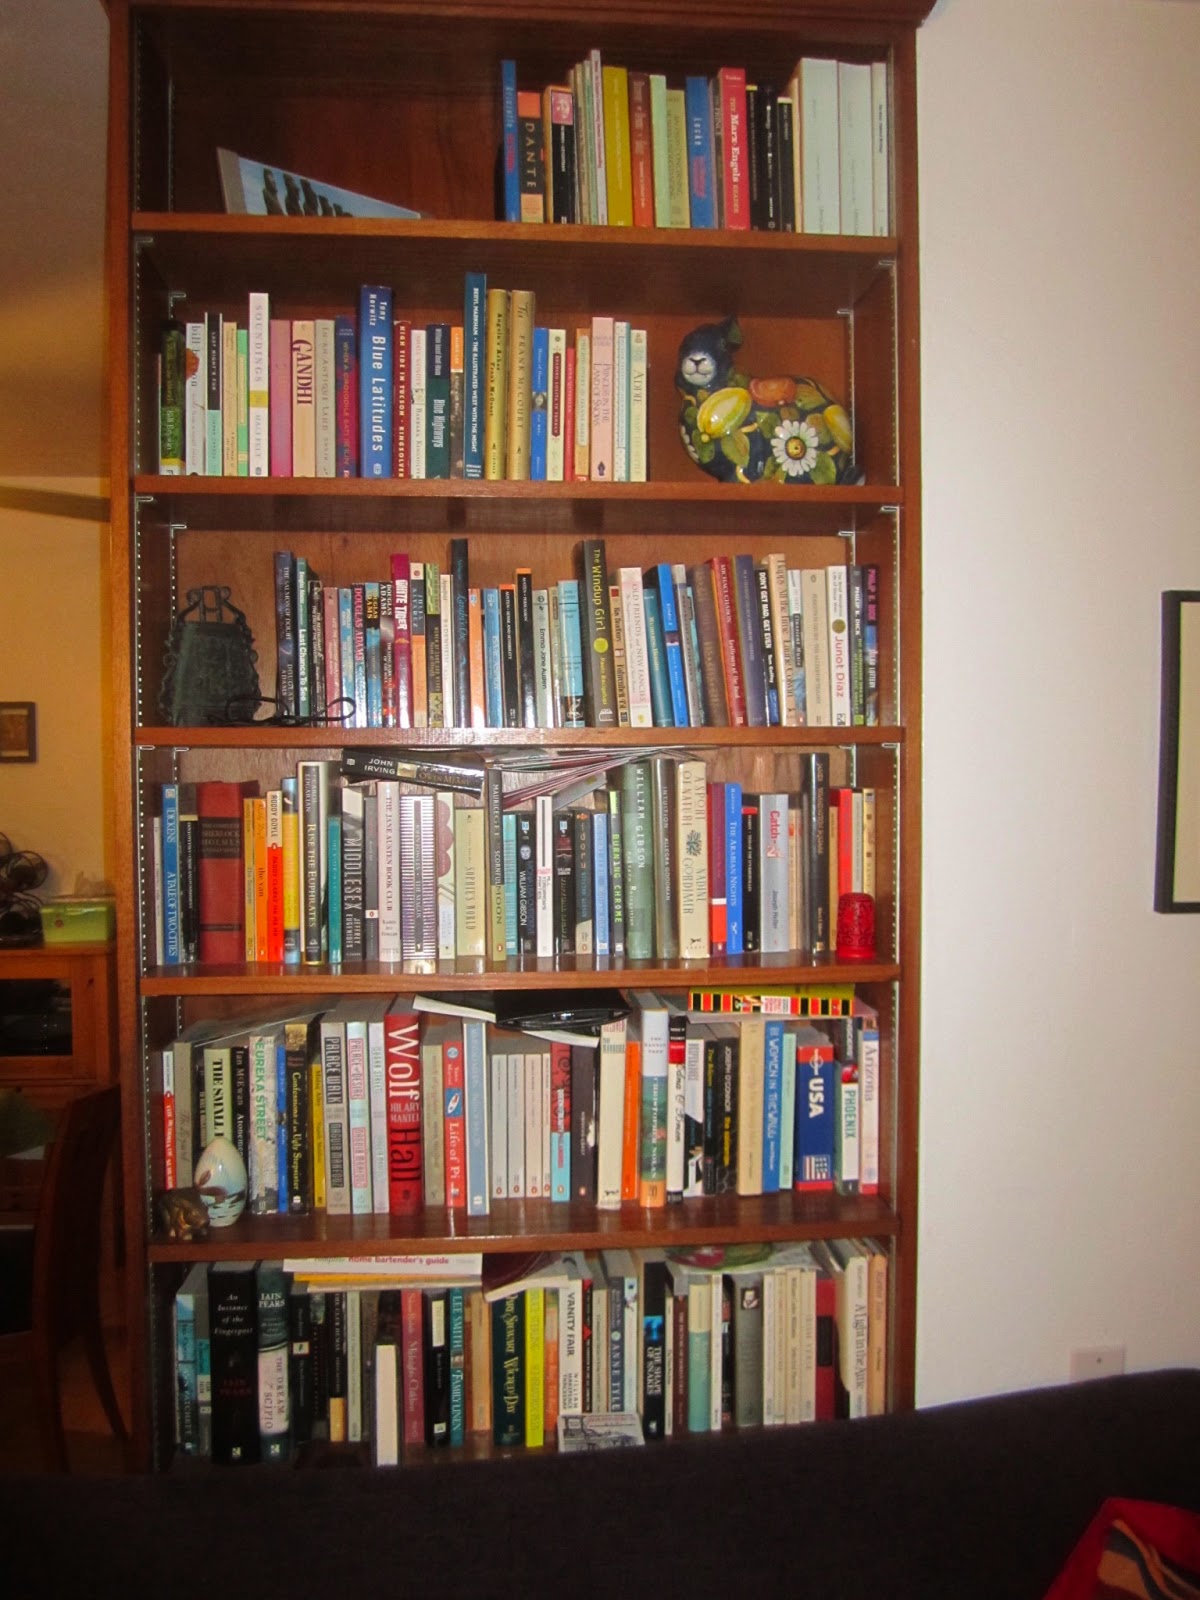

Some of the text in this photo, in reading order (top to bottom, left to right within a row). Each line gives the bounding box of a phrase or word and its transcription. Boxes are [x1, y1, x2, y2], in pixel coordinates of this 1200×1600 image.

[525, 122, 536, 188] DANTE
[369, 294, 377, 326] Horwitz
[255, 305, 263, 382] SOUNDINGS
[292, 340, 312, 405] GANDHI
[372, 336, 385, 451] Blue Latitudes
[433, 399, 445, 448] Blue Highways
[592, 566, 603, 605] Windup
[759, 572, 767, 589] DON'T
[760, 590, 768, 602] GET
[354, 588, 362, 628] DOUGLAS
[395, 580, 408, 630] WHITE TIGER
[595, 608, 605, 631] Girl
[763, 633, 772, 648] EVEN
[834, 636, 844, 669] Junot
[300, 677, 307, 685] To
[364, 765, 396, 775] IRVING
[369, 759, 393, 767] JOHN
[270, 795, 278, 817] RODDY
[385, 797, 393, 813] THE
[635, 768, 645, 868] WILLIAM GIBSON
[695, 784, 705, 820] SPORT
[385, 814, 393, 833] JANE
[385, 834, 393, 865] AUSTEN
[307, 823, 317, 927] RISE THE EUPHRATES
[344, 837, 361, 910] MIDDLESEX
[682, 858, 693, 914] GORDIMER
[696, 868, 706, 902] NADINE
[730, 877, 738, 906] NIGHTS
[212, 1059, 223, 1084] THE
[326, 1037, 342, 1103] PALACE WALK
[864, 1046, 877, 1101] Arizona
[255, 1042, 265, 1140] EUREKA STREET
[292, 1072, 301, 1117] Confessions
[388, 1023, 422, 1183] Wolf Hall
[809, 1078, 824, 1118] USA
[845, 1090, 855, 1138] PHOENIX
[292, 1133, 301, 1151] Ugly
[449, 1123, 460, 1179] Life of Pi
[293, 1152, 302, 1190] Stepsister
[258, 1300, 285, 1309] PEARS
[452, 1295, 461, 1347] LEE SMITH
[567, 1292, 575, 1331] VANITY
[647, 1347, 654, 1358] OF
[277, 1377, 285, 1414] DREAM
